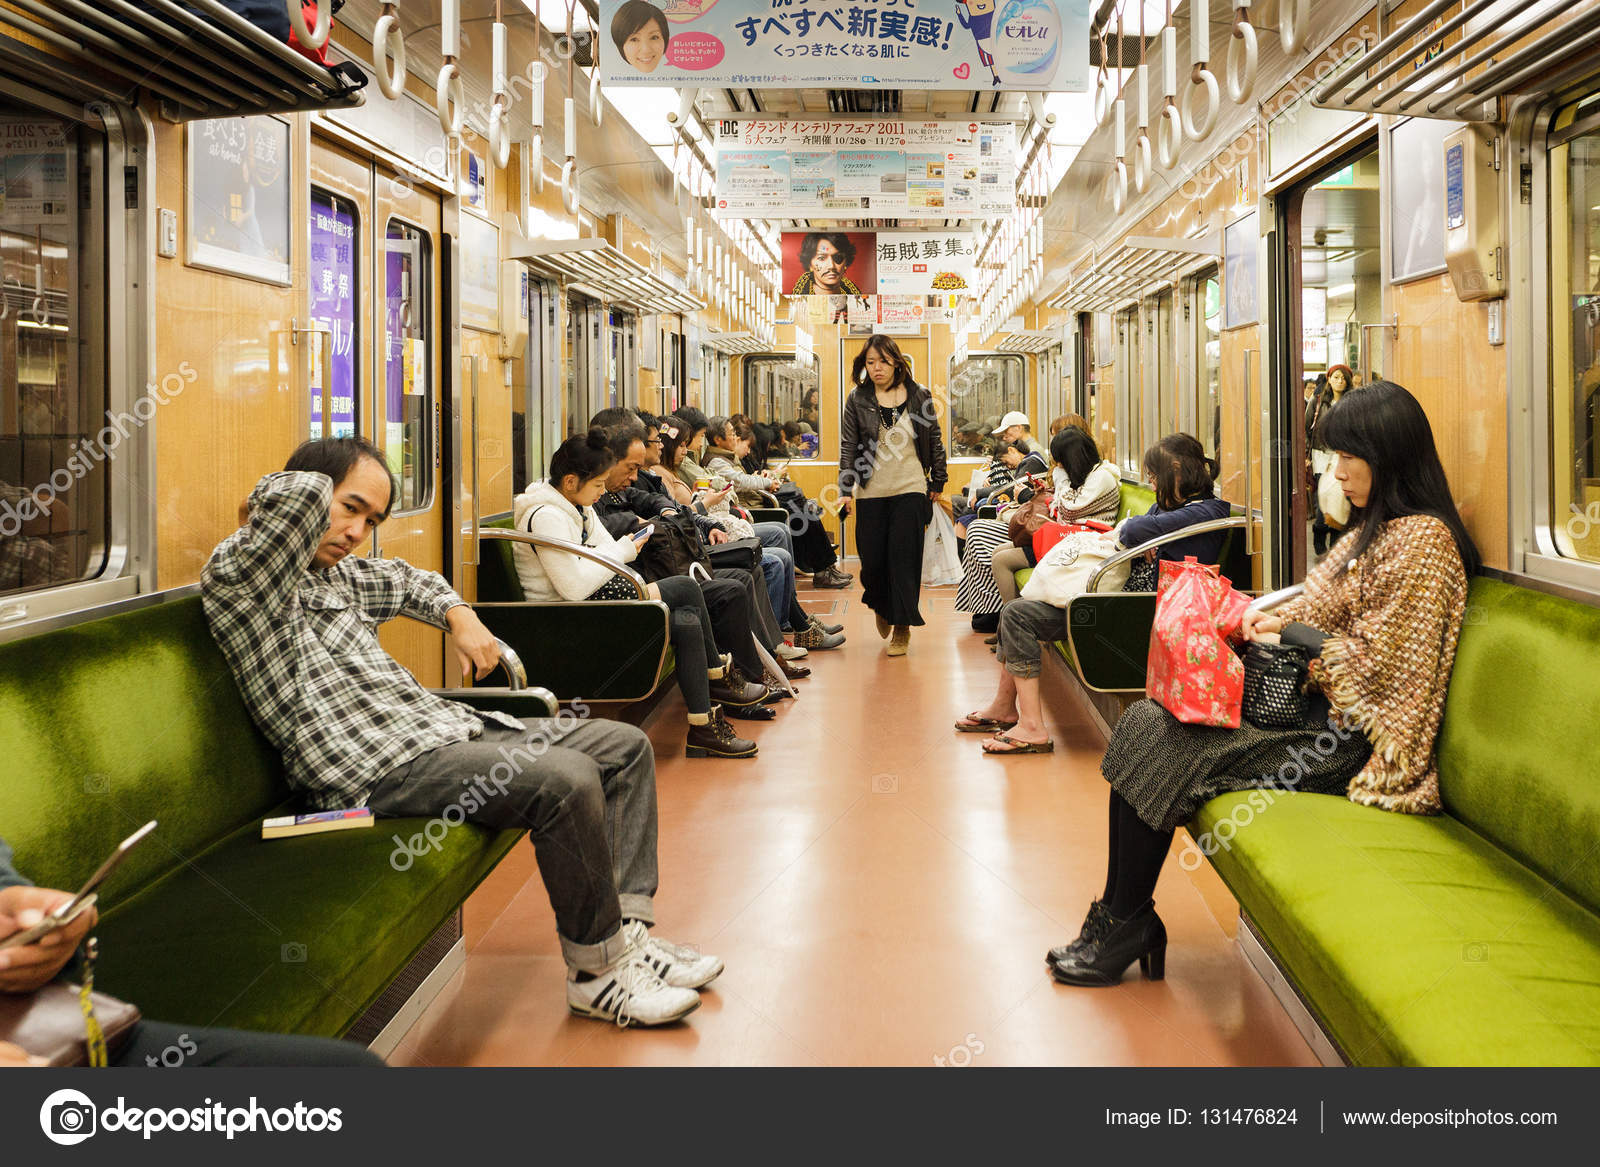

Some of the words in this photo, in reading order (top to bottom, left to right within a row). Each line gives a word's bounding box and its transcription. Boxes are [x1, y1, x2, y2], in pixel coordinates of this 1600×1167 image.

[735, 6, 953, 50] すべすべ新実感!
[773, 43, 910, 58] くっつきたくなる肌に
[745, 121, 788, 135] グランド
[791, 122, 842, 135] インテリア
[844, 122, 875, 135] フェア
[878, 122, 905, 135] 2011
[791, 135, 832, 145] 一斉開催
[877, 238, 973, 262] 海賊募集。
